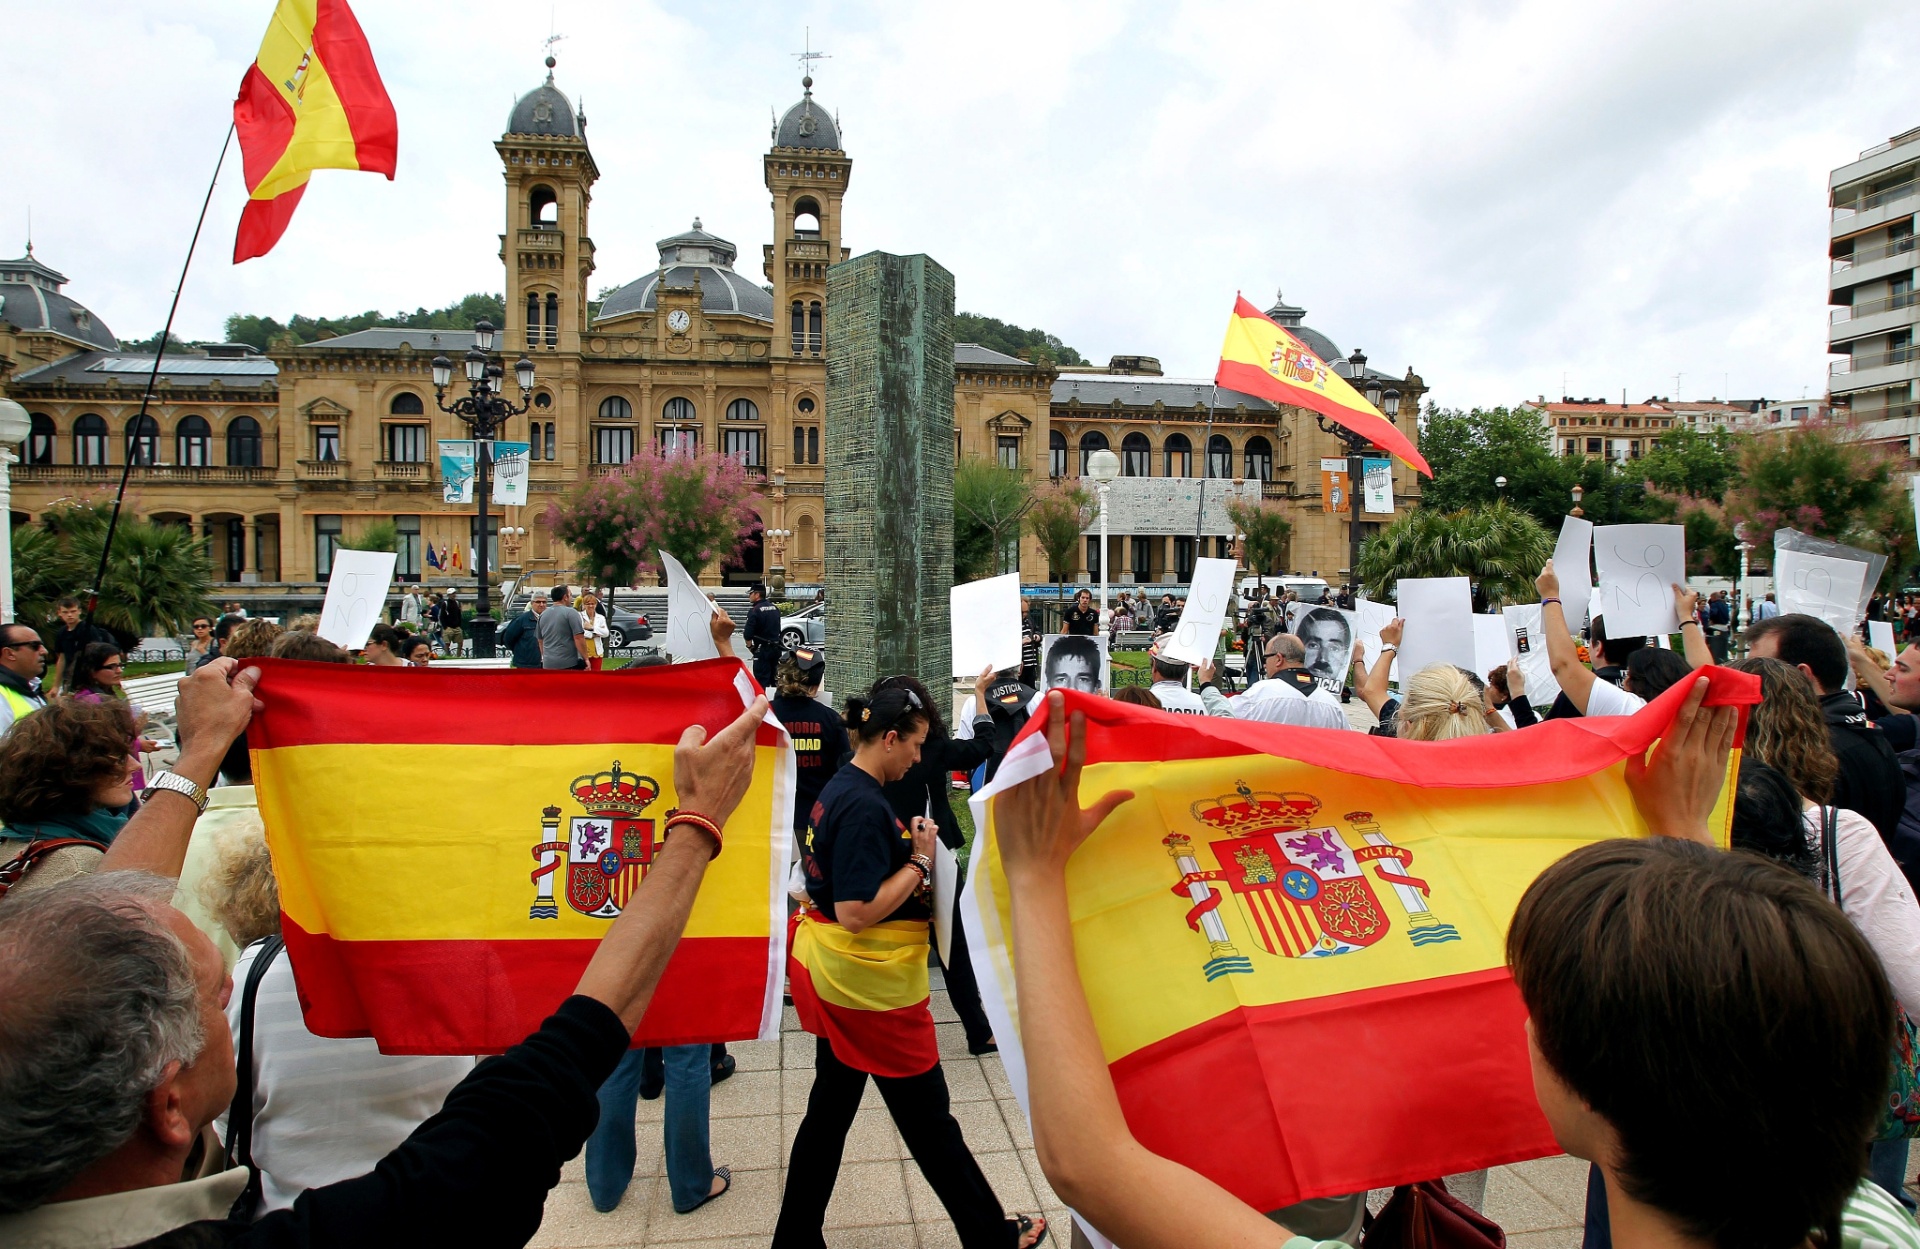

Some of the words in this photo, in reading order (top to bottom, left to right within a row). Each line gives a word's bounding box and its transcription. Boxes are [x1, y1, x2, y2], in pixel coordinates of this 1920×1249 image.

[1613, 544, 1668, 611] 36
[992, 683, 1023, 699] JUSTICIA
[1360, 846, 1405, 858] VLTRA
[1182, 871, 1217, 885] PLVS
